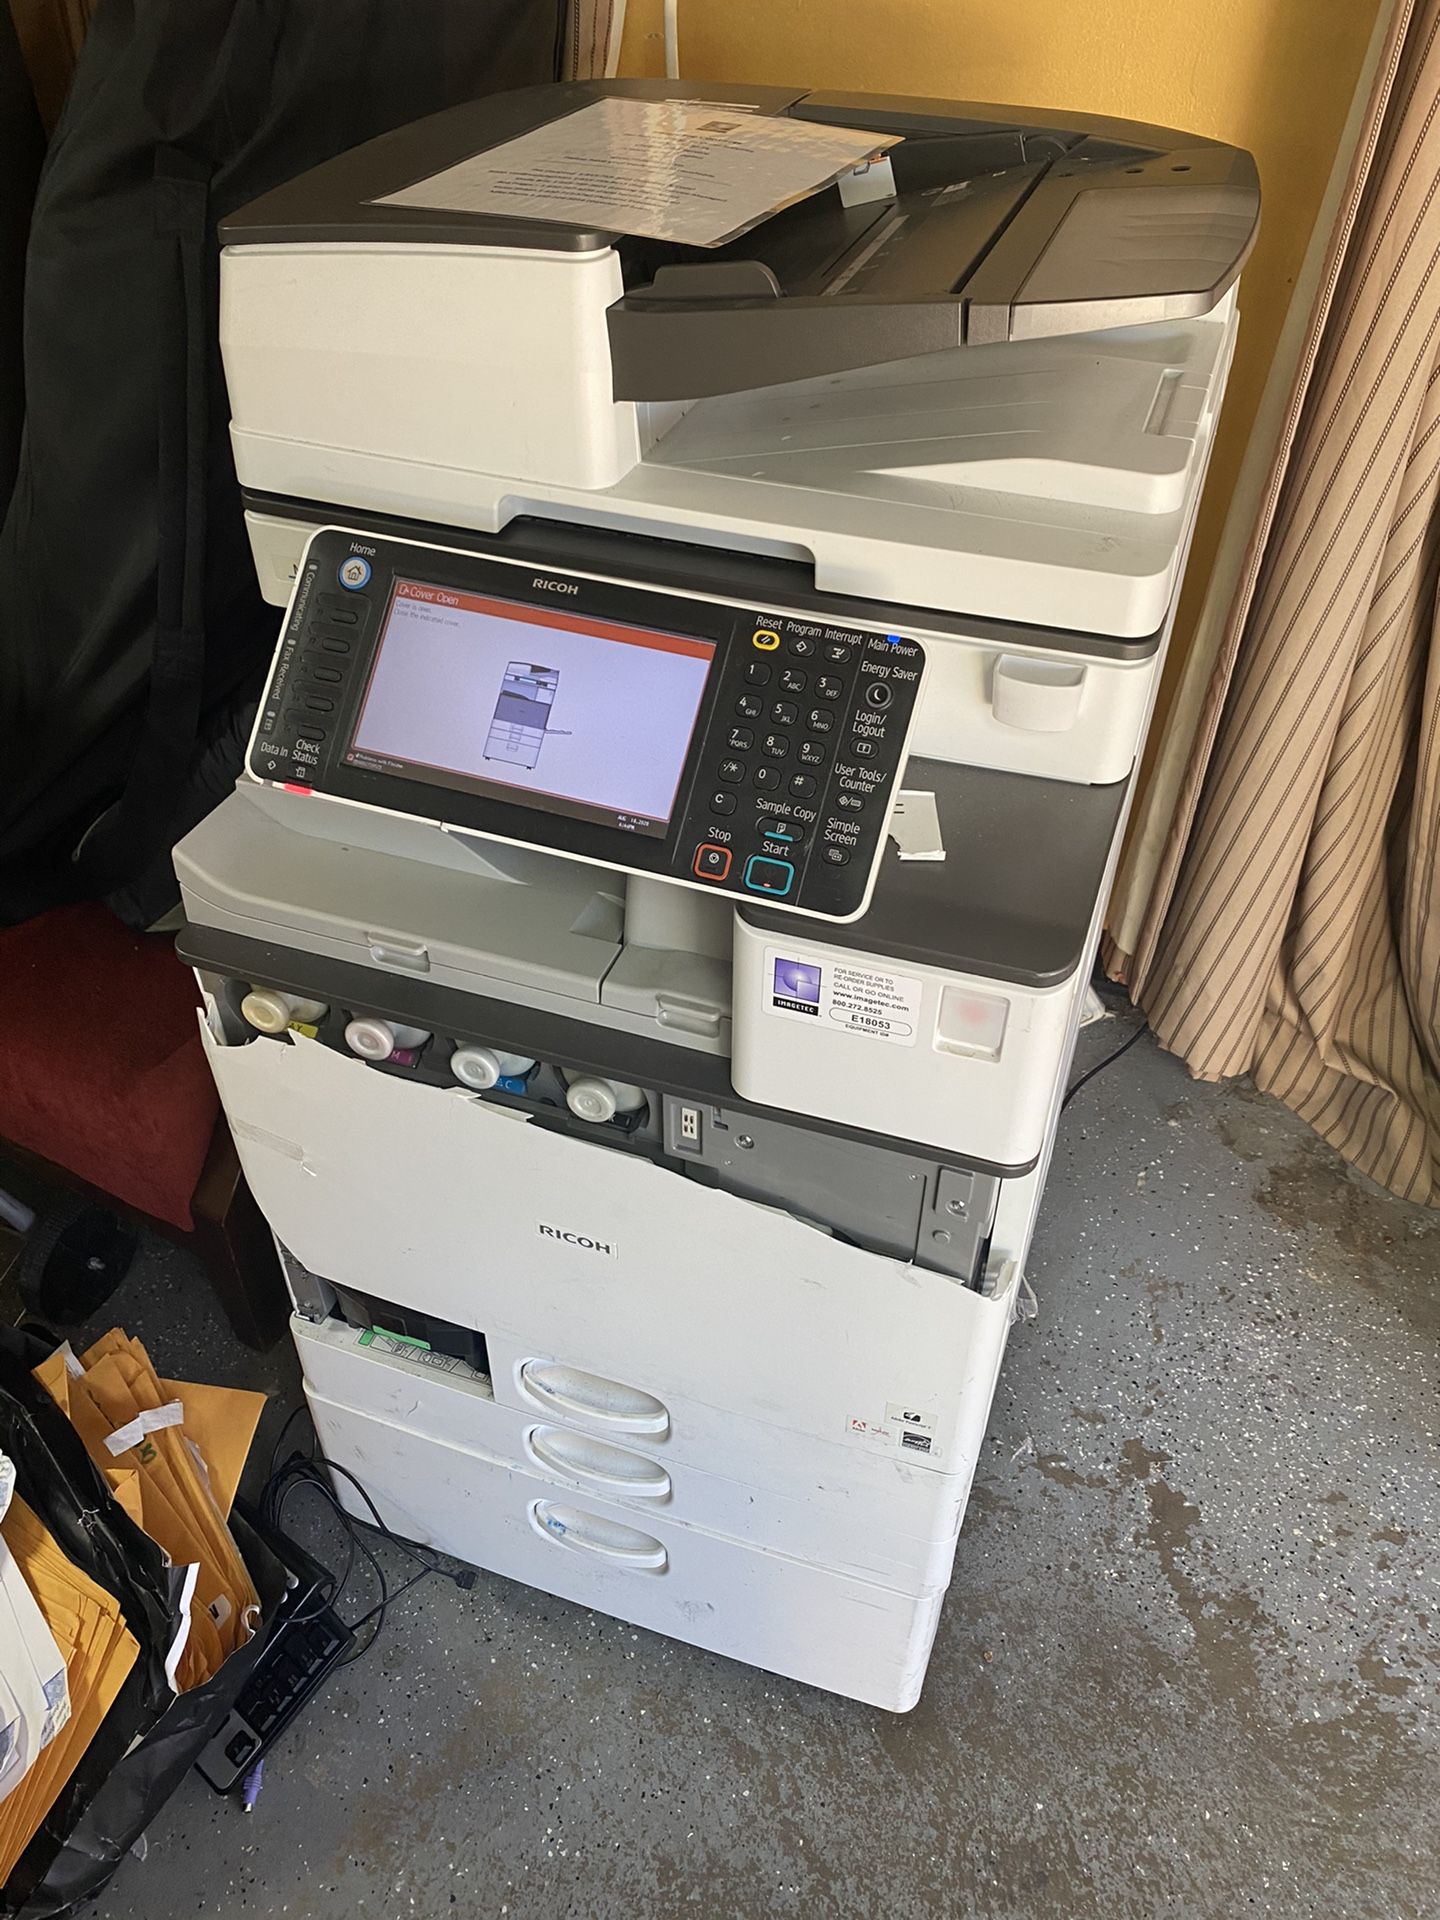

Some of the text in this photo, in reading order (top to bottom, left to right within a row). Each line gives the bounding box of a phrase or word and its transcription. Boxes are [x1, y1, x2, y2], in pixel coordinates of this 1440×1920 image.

[350, 542, 376, 557] Home
[532, 578, 579, 595] RICOH
[290, 571, 315, 631] Communicating
[410, 586, 459, 606] Cover Open
[756, 615, 863, 645] Reset Program Interrupt
[867, 638, 918, 657] Main Power
[271, 646, 294, 700] Fax Received
[749, 664, 755, 674] 1
[783, 671, 791, 681] 2
[861, 661, 918, 680] Energy Saver
[787, 682, 801, 692] ABC
[819, 677, 827, 688] 3
[739, 696, 747, 707] 4
[775, 703, 783, 713] 5
[811, 710, 819, 721] 6
[855, 709, 887, 725] Login/
[731, 728, 740, 739] 7
[812, 721, 829, 730] MNO
[852, 722, 886, 738] Logout
[260, 741, 288, 757] Data In
[296, 738, 320, 755] Check
[766, 736, 775, 746] 8
[802, 743, 811, 753] 9
[292, 750, 318, 765] Status
[771, 747, 784, 755] TUV
[801, 753, 820, 763] WXYZ
[758, 768, 767, 779] 0
[834, 762, 887, 783] User Tools/
[839, 776, 876, 793] Counter
[714, 793, 724, 804] C
[756, 797, 817, 823] Sample Copy
[826, 817, 861, 834] Simple
[708, 826, 731, 843] Stop
[823, 830, 857, 846] Screen
[762, 840, 790, 857] Start
[848, 970, 873, 981] SERVICE
[833, 982, 851, 991] CALL
[877, 992, 904, 1002] ONLINE
[866, 981, 895, 992] SUPPLIES
[777, 999, 815, 1014] IMAGETEC
[832, 999, 882, 1015] 800.272.8525
[833, 990, 910, 1012] www.imagetec.com
[845, 1024, 878, 1035] EQUIPMENT
[851, 1014, 890, 1030] E18053
[505, 1081, 513, 1090] C
[539, 1224, 611, 1255] RICOH
